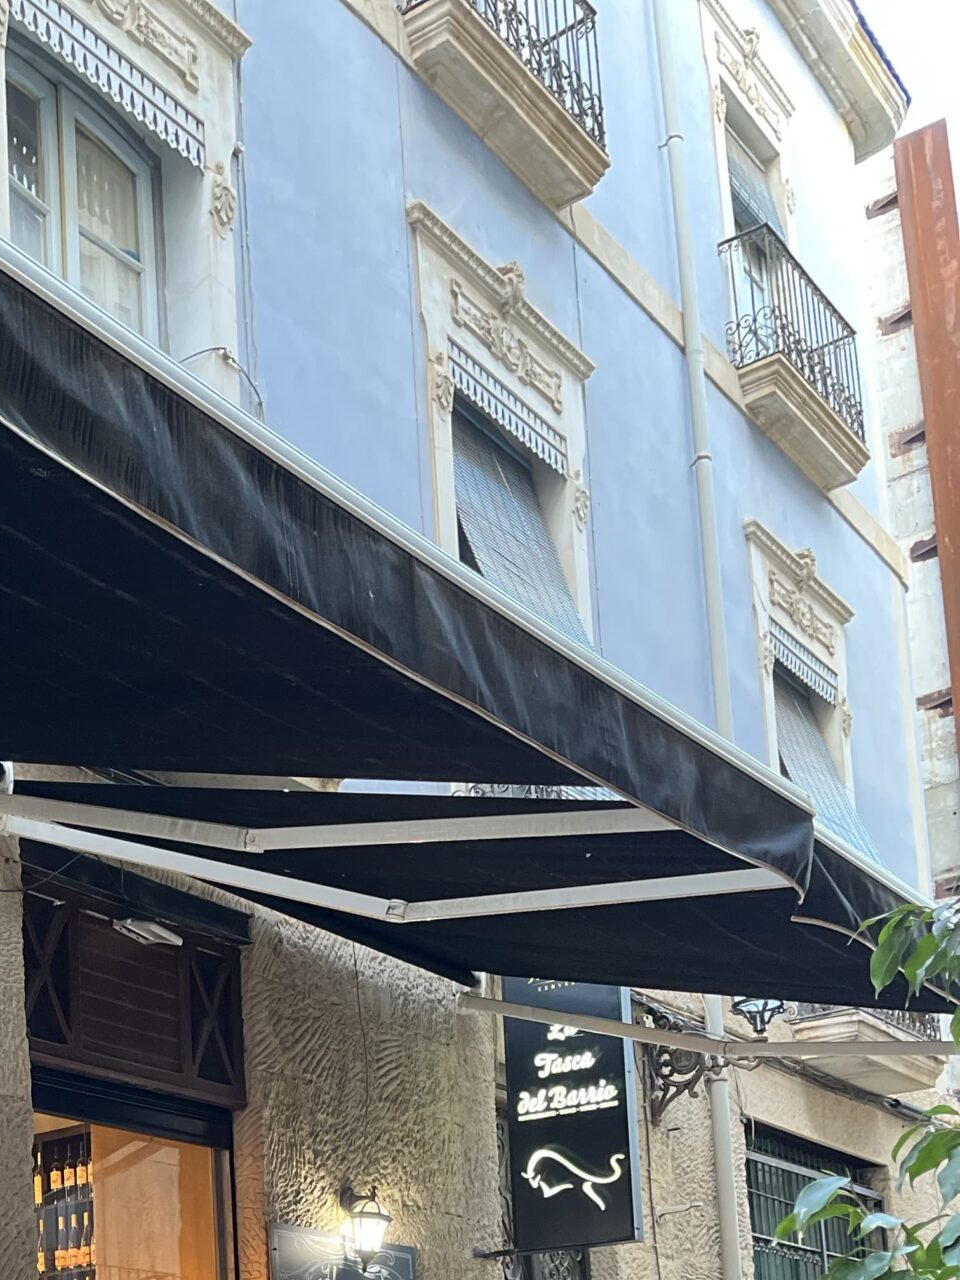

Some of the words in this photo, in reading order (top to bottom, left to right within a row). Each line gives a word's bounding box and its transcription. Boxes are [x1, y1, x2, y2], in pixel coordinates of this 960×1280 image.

[534, 1051, 596, 1078] Tasca
[517, 1089, 548, 1114] del
[548, 1079, 618, 1109] Barrio
